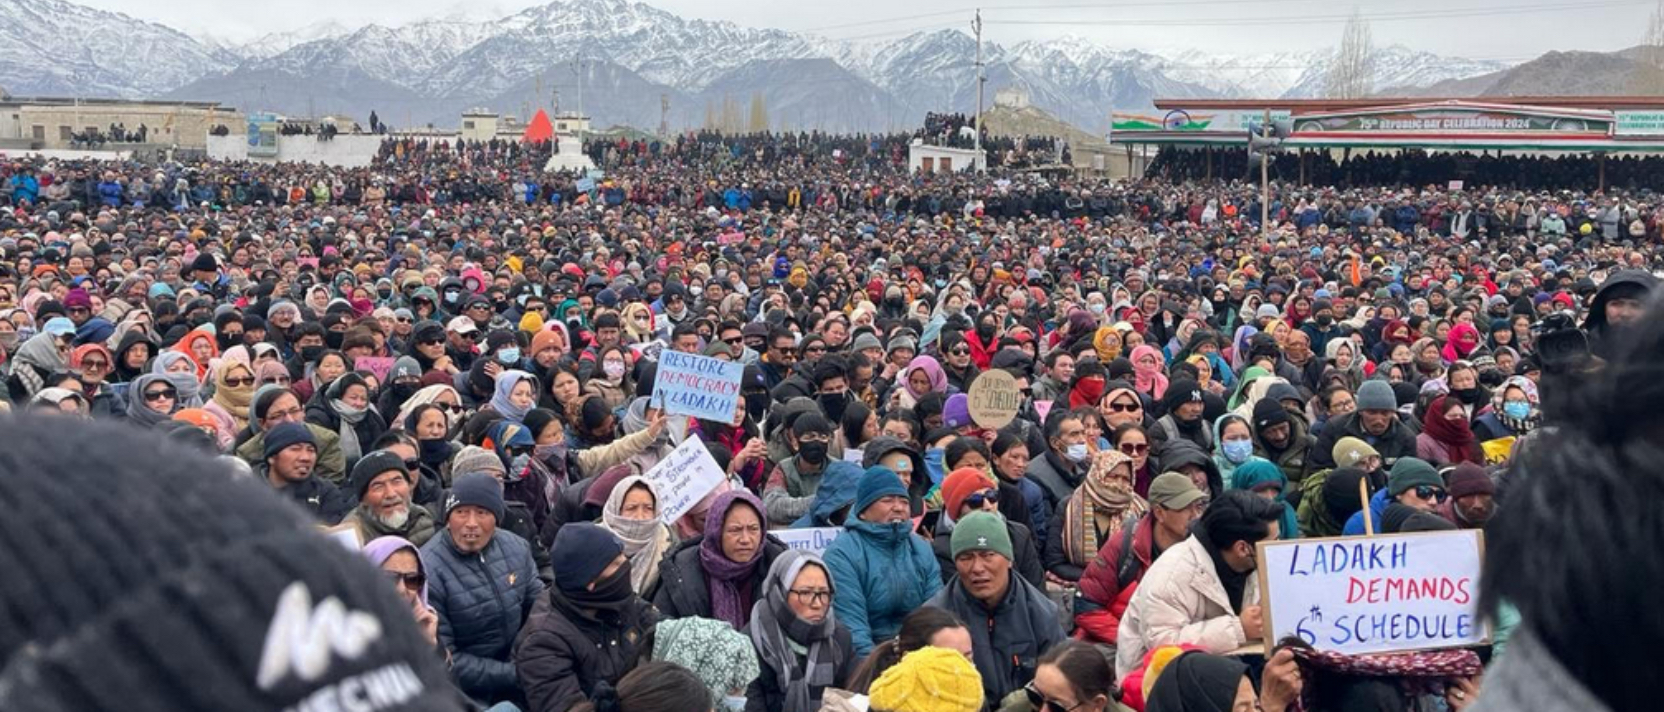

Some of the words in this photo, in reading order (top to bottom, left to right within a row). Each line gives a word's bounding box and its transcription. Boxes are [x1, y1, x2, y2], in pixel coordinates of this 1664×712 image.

[1379, 119, 1422, 130] REPUBLIC
[1423, 119, 1442, 130] DAY
[1443, 118, 1504, 130] CELEBRATION
[1505, 118, 1530, 129] 2024
[664, 352, 726, 375] RESTORE
[659, 370, 740, 396] DEMOCRACY
[671, 391, 732, 415] LADAKH
[1289, 541, 1407, 577] LADAKH
[1346, 576, 1471, 605] DEMANDS
[1331, 613, 1472, 645] SCHEDULE
